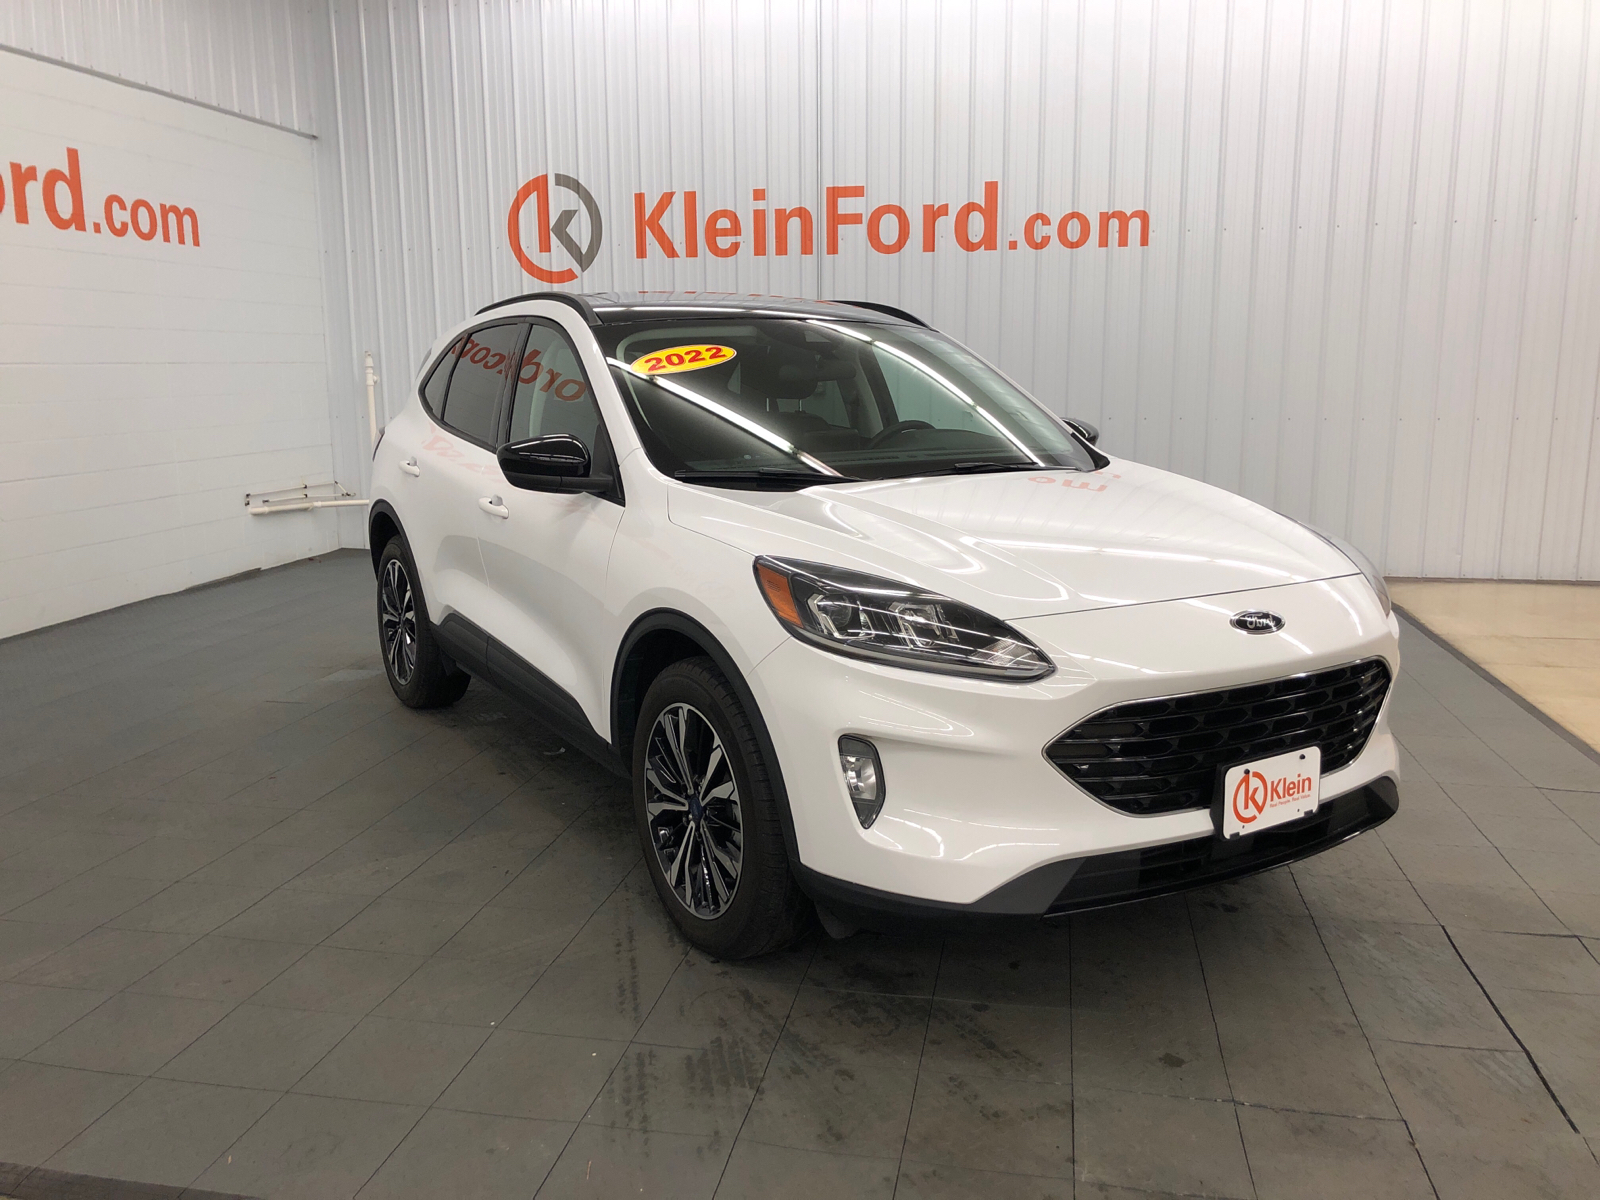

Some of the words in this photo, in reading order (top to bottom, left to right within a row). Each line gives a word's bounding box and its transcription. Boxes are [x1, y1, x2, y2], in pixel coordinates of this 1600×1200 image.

[0, 147, 200, 247] rd.com
[634, 181, 1150, 259] KleinFord.com
[644, 346, 728, 373] 2022
[1270, 773, 1312, 802] Klein
